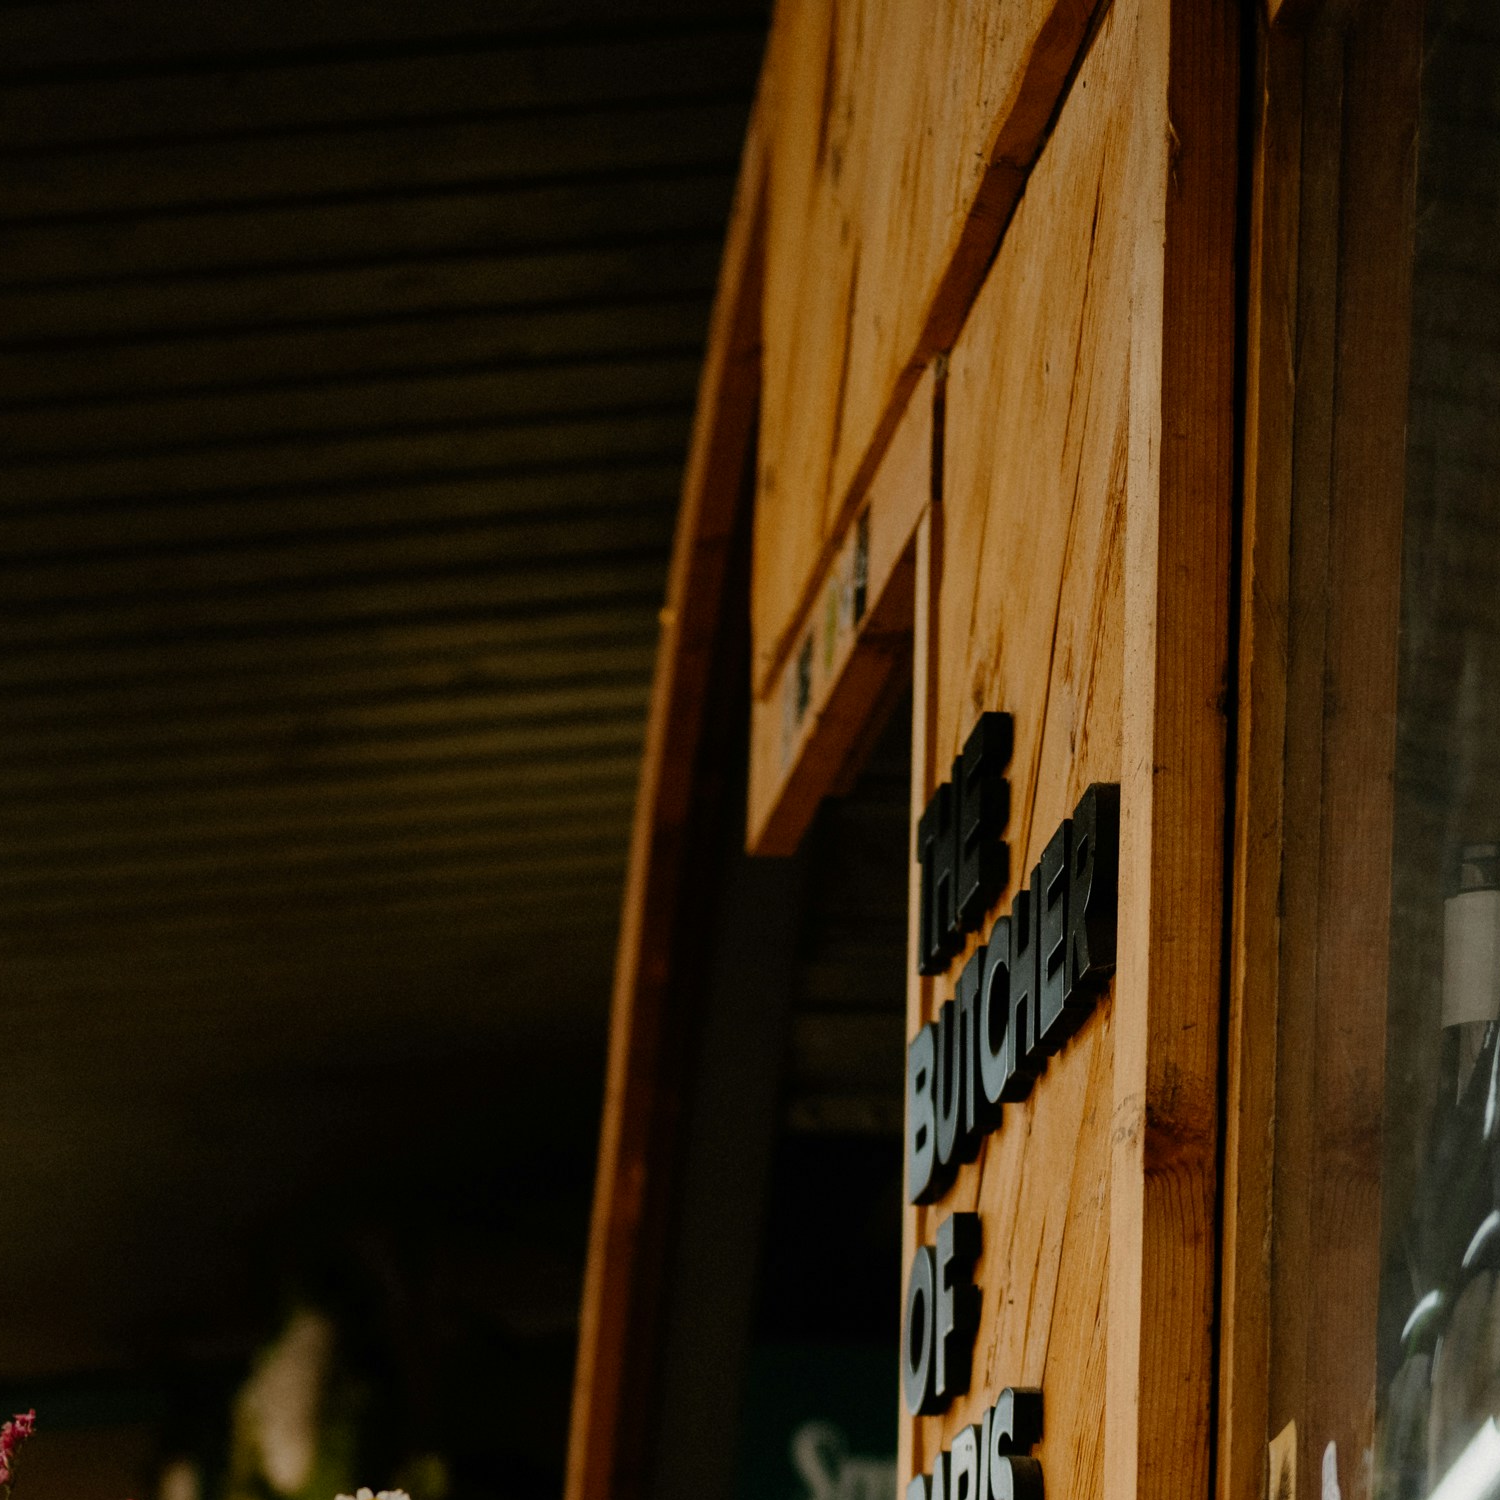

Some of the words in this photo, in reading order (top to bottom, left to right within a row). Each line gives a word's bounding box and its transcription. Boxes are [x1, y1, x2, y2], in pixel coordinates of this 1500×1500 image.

[917, 710, 1010, 976] THE
[907, 781, 1120, 1204] BUTCHER
[904, 1211, 980, 1416] OF
